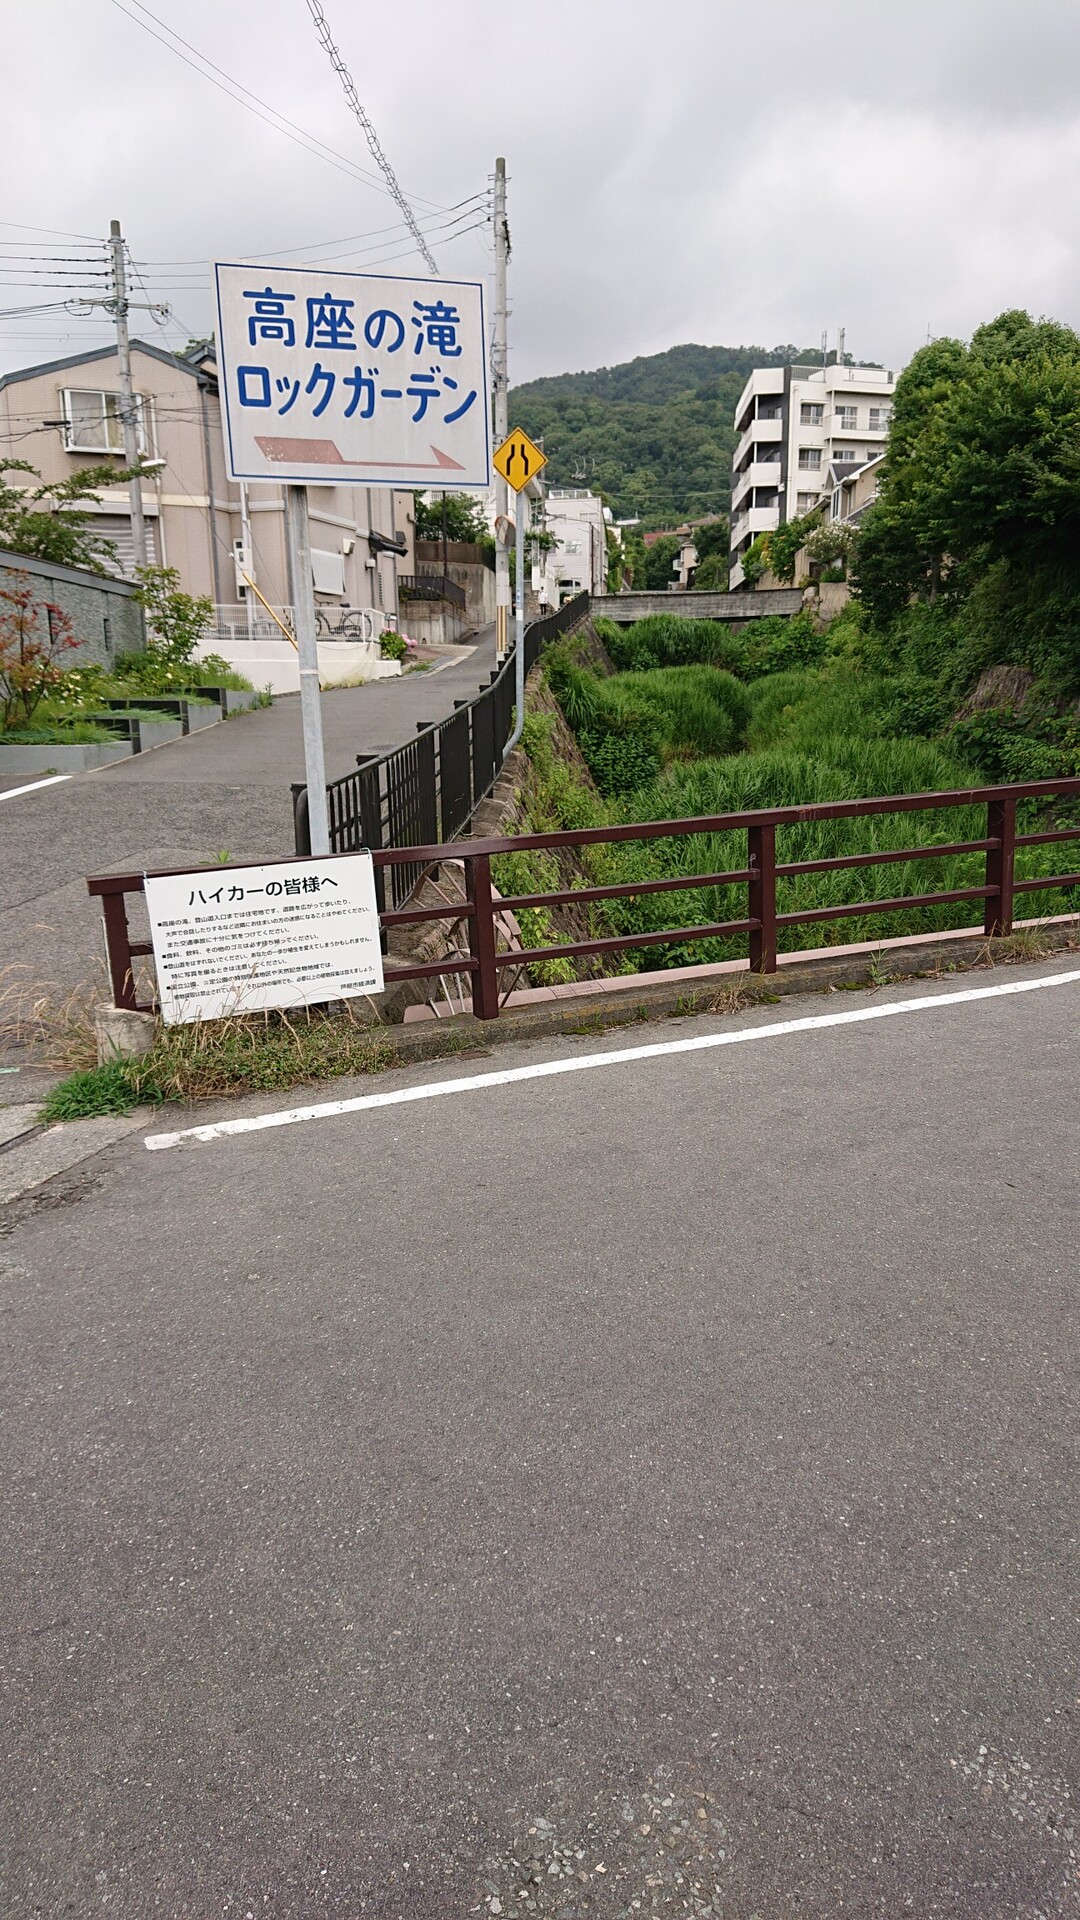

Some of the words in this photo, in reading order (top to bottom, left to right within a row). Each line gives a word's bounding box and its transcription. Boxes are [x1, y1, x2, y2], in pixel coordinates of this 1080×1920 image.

[242, 286, 462, 357] 高座の滝
[237, 363, 477, 423] ロックガーデン
[188, 876, 338, 906] ハイカーの皆様へ
